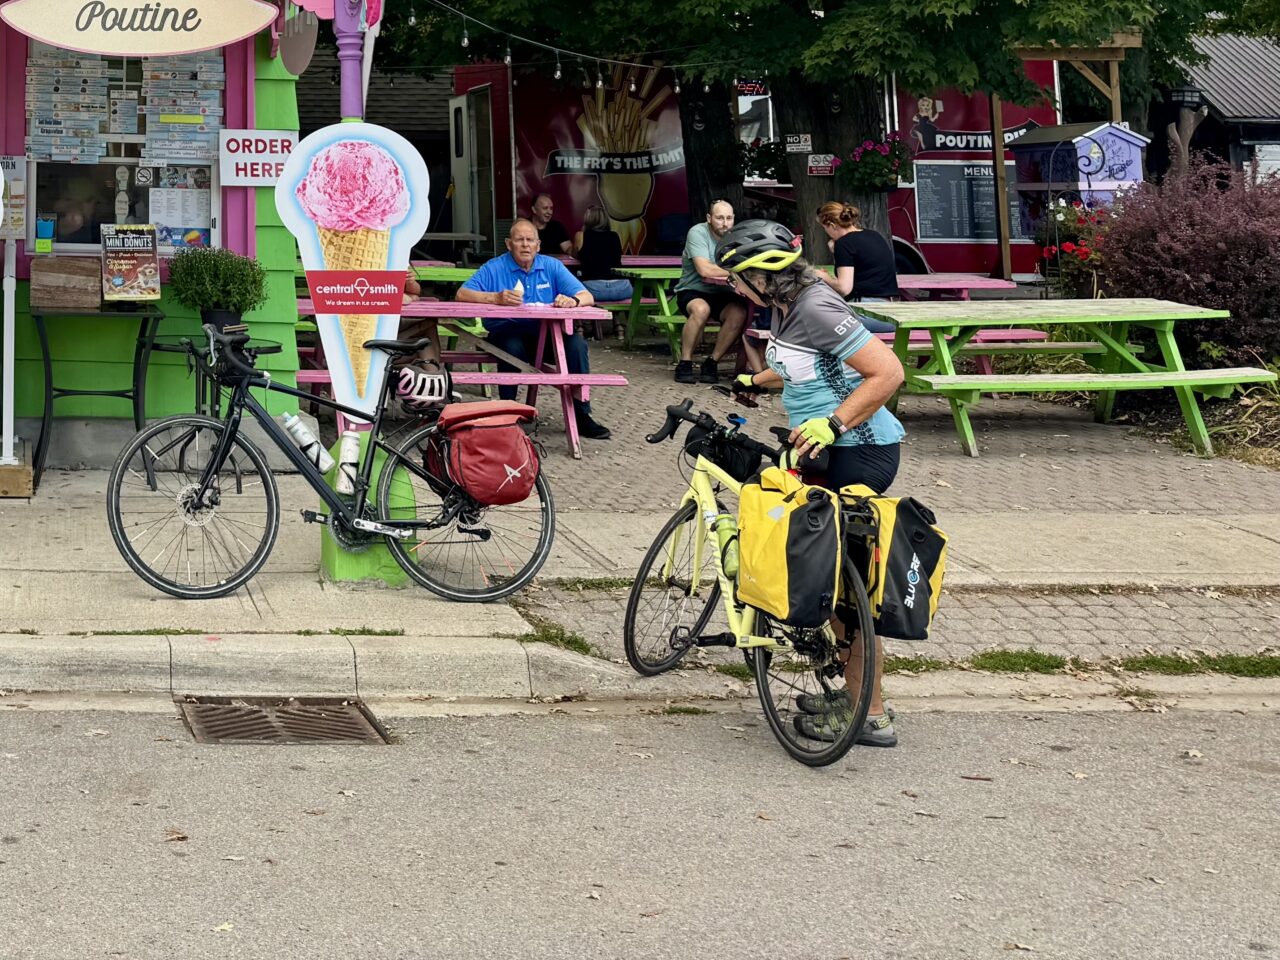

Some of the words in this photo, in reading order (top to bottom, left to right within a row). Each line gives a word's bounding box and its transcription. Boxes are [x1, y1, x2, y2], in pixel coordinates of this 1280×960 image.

[75, 0, 202, 32] Poutine
[225, 137, 293, 154] ORDER
[235, 162, 285, 178] HERE
[555, 156, 581, 169] THE
[583, 156, 622, 170] FRY'S
[623, 156, 651, 170] THE
[106, 238, 122, 247] MINI
[124, 238, 153, 247] DONUTS
[316, 283, 354, 294] central
[369, 283, 398, 294] smith
